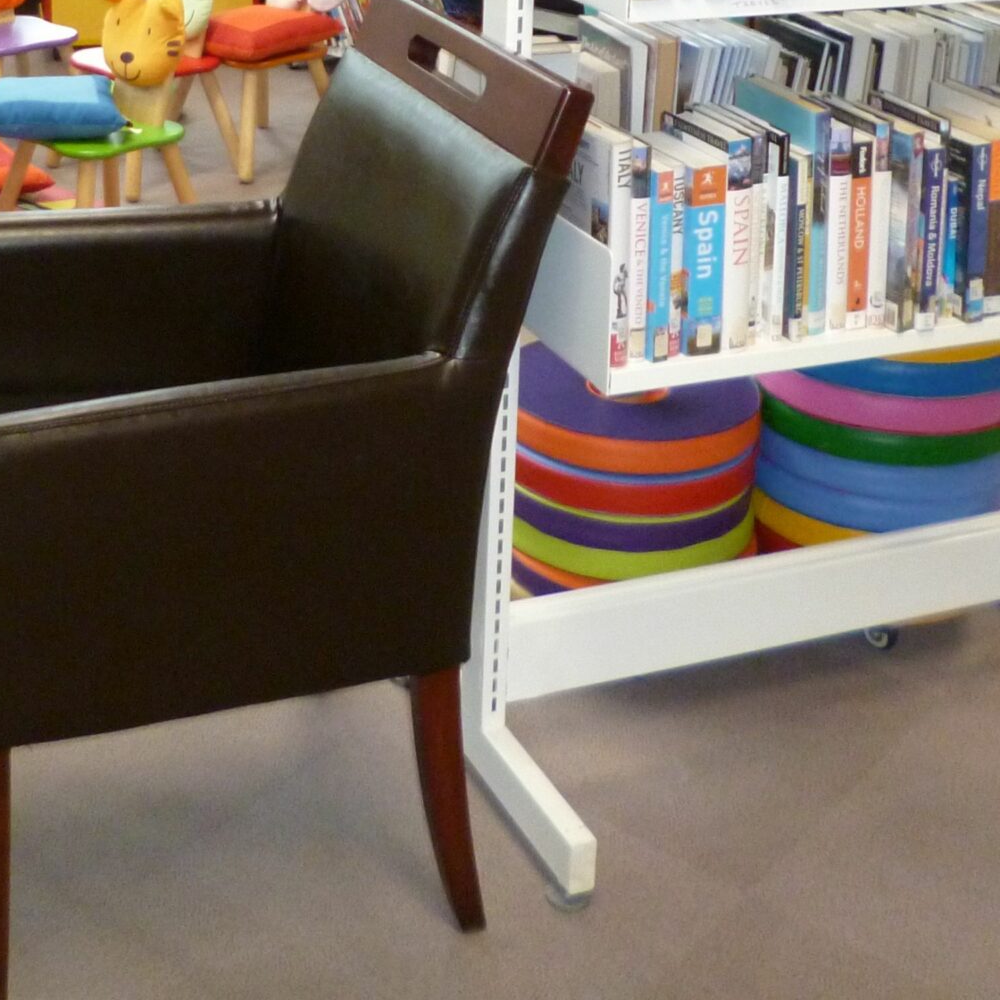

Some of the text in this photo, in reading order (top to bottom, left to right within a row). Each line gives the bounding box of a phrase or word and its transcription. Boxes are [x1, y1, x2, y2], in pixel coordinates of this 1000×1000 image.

[617, 148, 632, 189] ITALY
[976, 179, 987, 211] Nepal
[635, 202, 647, 257] VENICE
[672, 176, 684, 235] TUSCANY
[732, 194, 750, 267] SPAIN
[854, 186, 867, 249] HOLLAND
[928, 185, 941, 231] Romania
[950, 207, 958, 239] DUBAI
[694, 209, 718, 279] Spain
[836, 208, 847, 286] NETHERLANDS
[925, 242, 936, 287] Moldova
